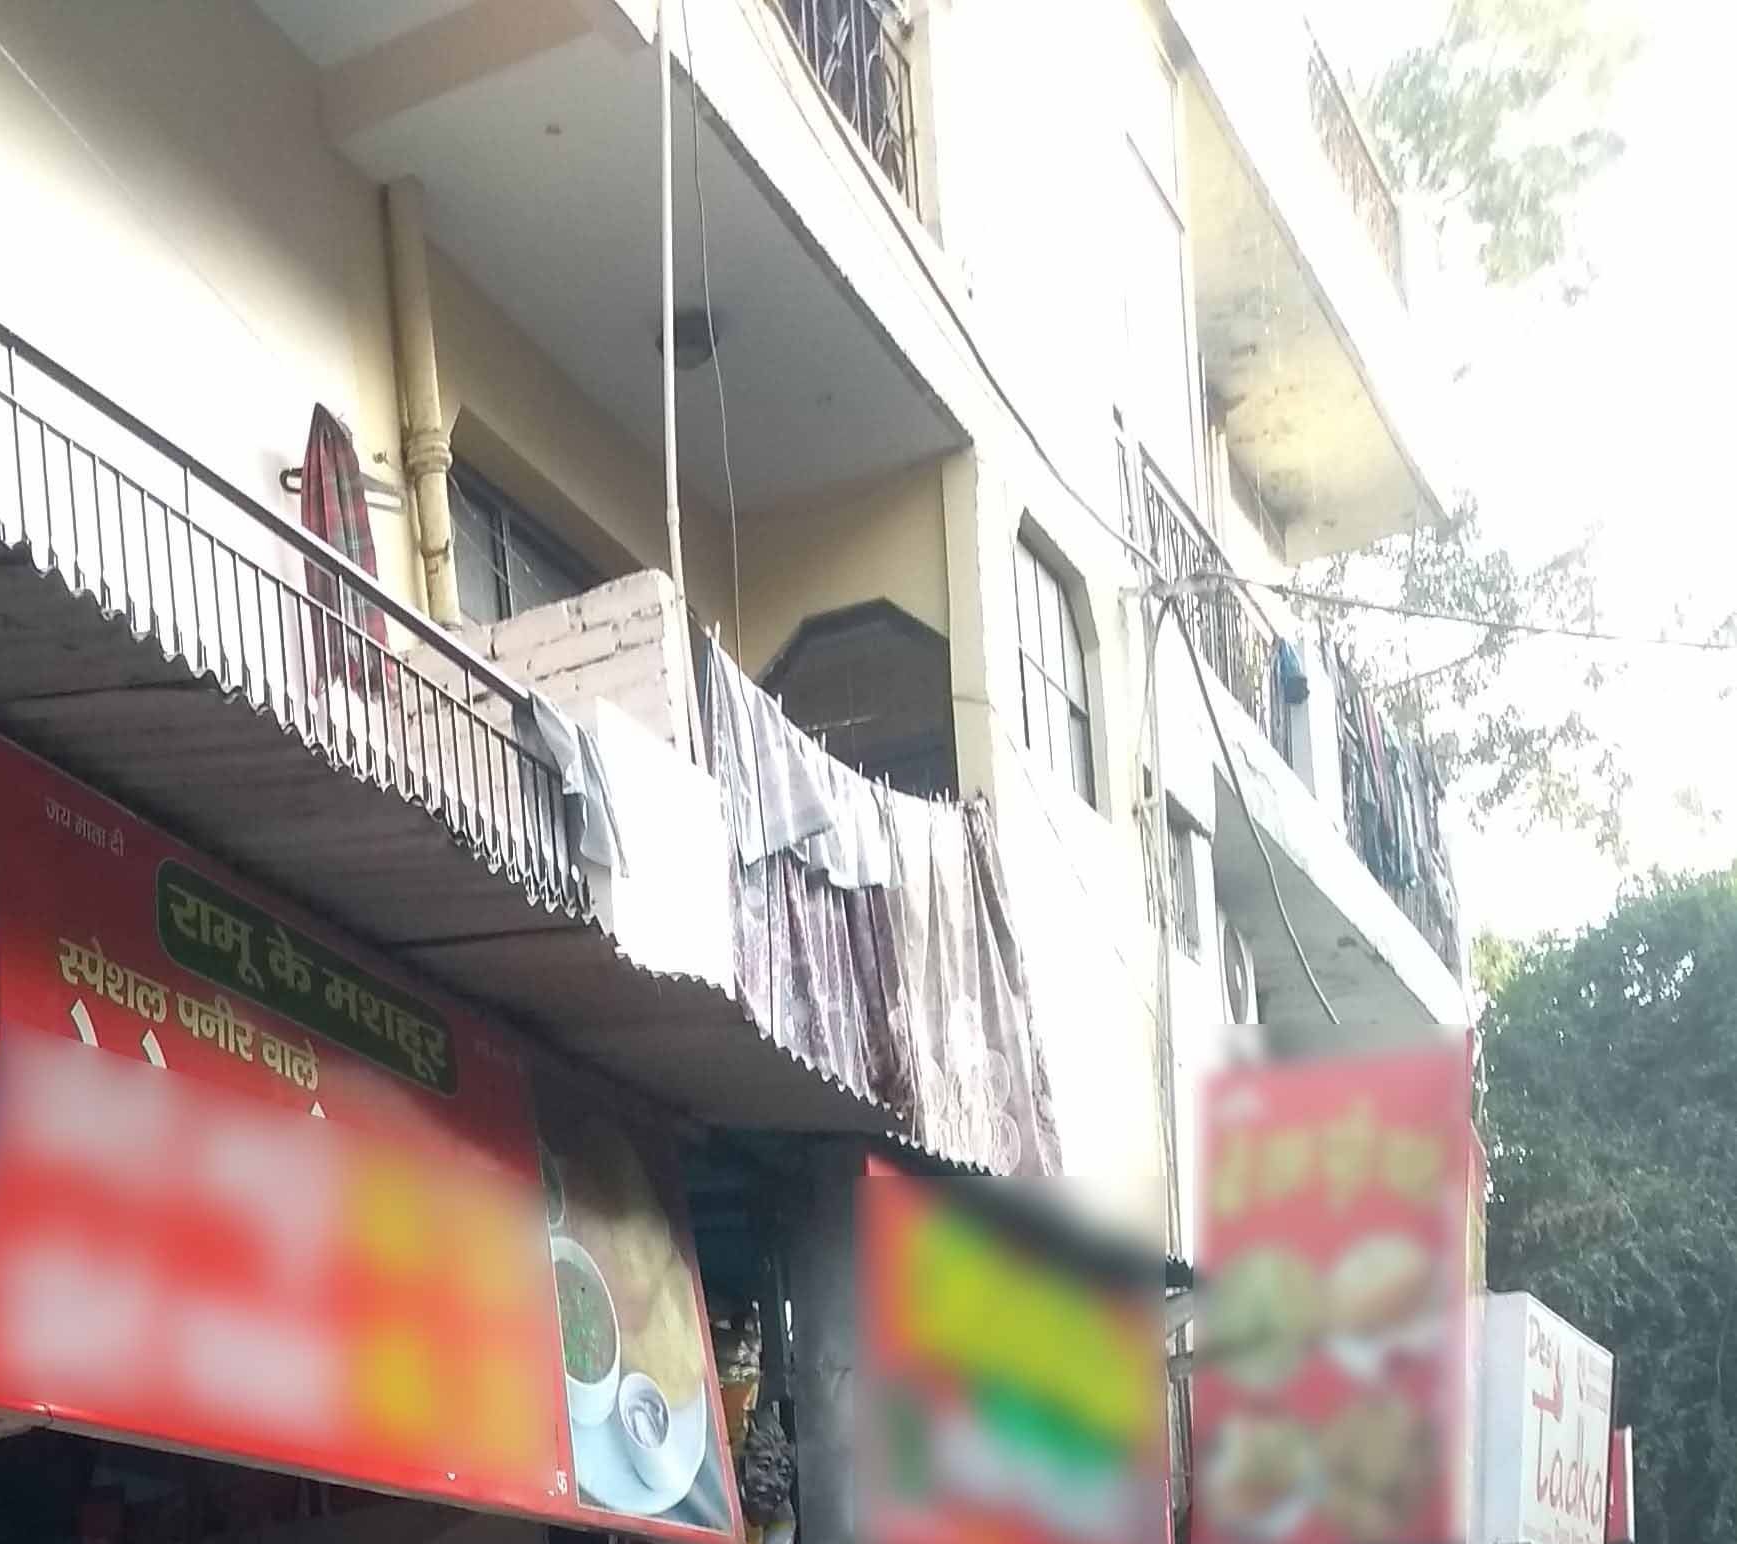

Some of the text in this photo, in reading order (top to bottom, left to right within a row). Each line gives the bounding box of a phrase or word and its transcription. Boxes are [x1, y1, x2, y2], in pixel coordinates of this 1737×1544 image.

[59, 936, 169, 1024] स्पेशल
[175, 993, 255, 1062] पनीर
[261, 1028, 320, 1091] वाले
[166, 882, 448, 1083] रामू के मशहूर
